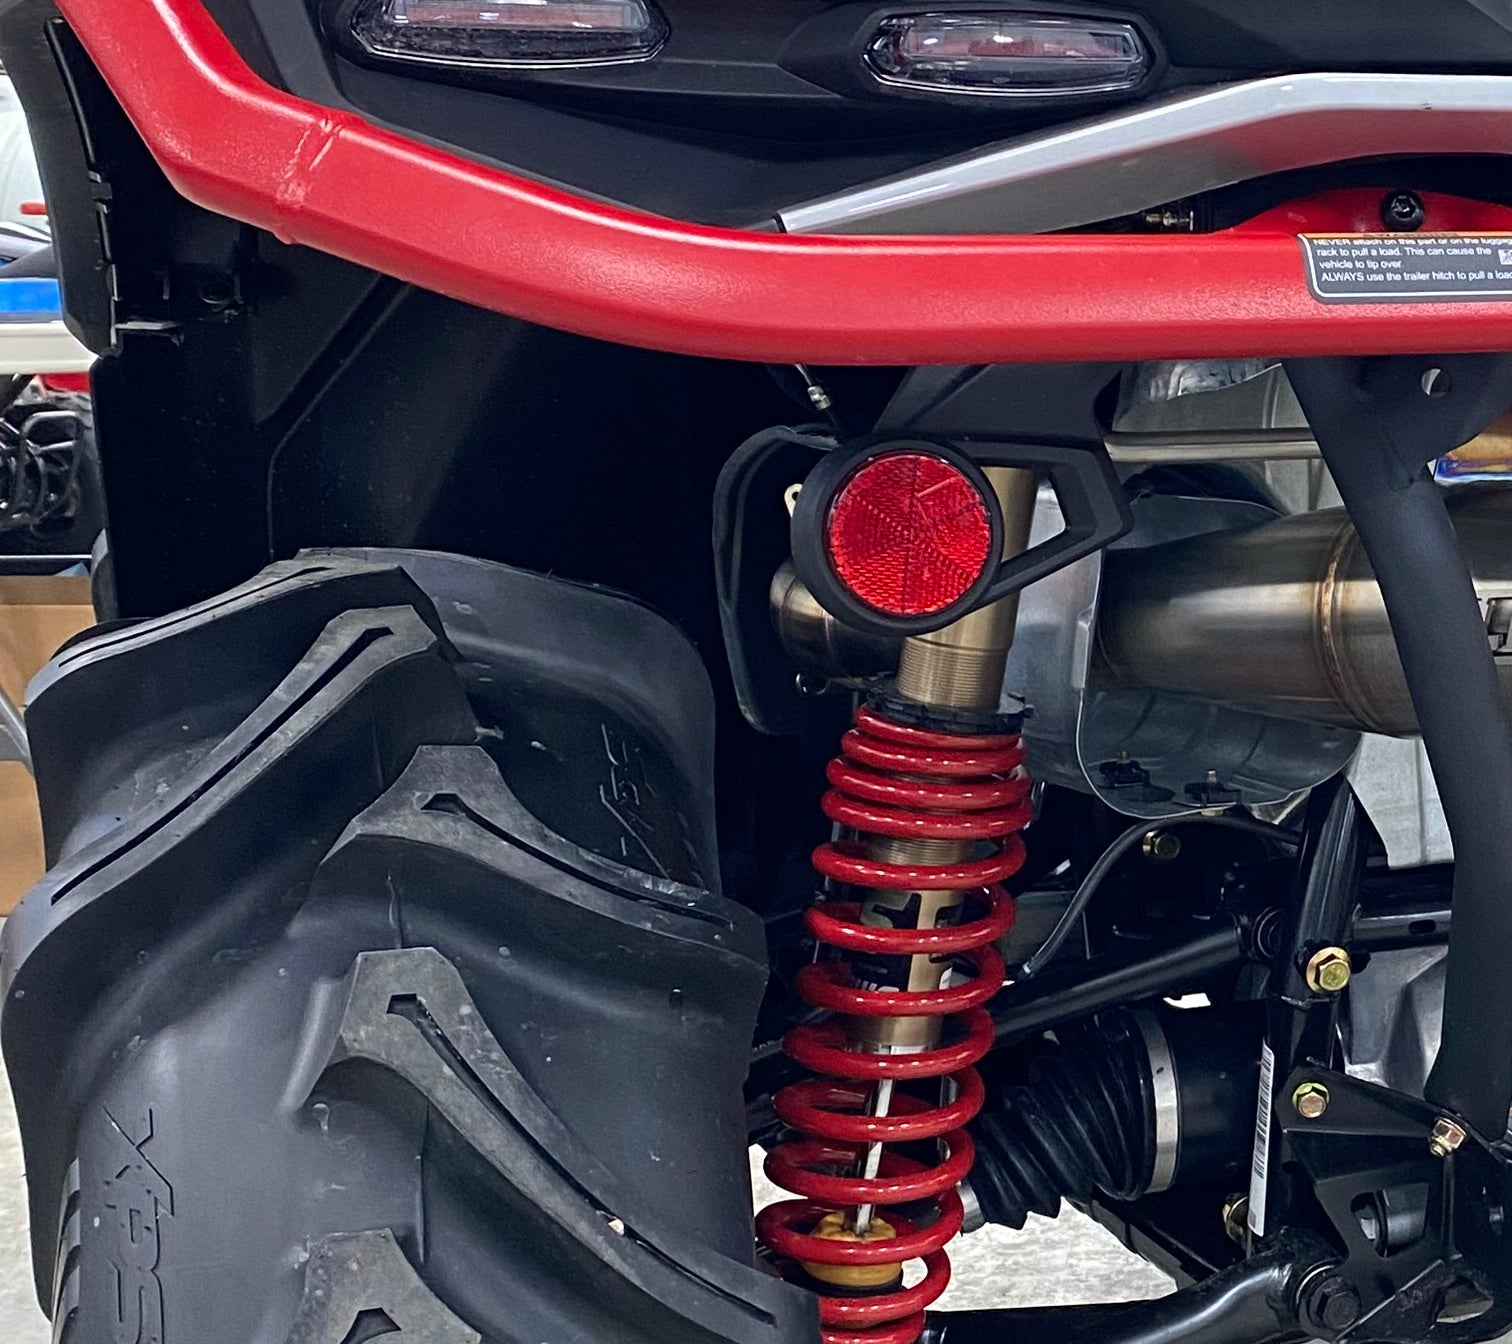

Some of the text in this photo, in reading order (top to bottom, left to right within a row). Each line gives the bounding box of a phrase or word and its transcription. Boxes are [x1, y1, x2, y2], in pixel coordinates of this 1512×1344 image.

[1317, 247, 1338, 256] rack
[1340, 248, 1350, 256] to
[1351, 247, 1368, 257] pull
[1379, 247, 1402, 256] load.
[1404, 247, 1425, 256] This
[1476, 247, 1491, 255] the
[1319, 260, 1353, 269] vehicle
[1355, 260, 1364, 268] to
[1366, 260, 1379, 270] tip
[1321, 272, 1364, 282] ALWAYS
[1367, 273, 1384, 281] use
[1386, 272, 1402, 281] the
[1403, 271, 1430, 281] trailer
[1432, 271, 1455, 280] hitch
[1457, 271, 1466, 280] to
[1468, 271, 1485, 282] pull
[1487, 272, 1493, 280] a
